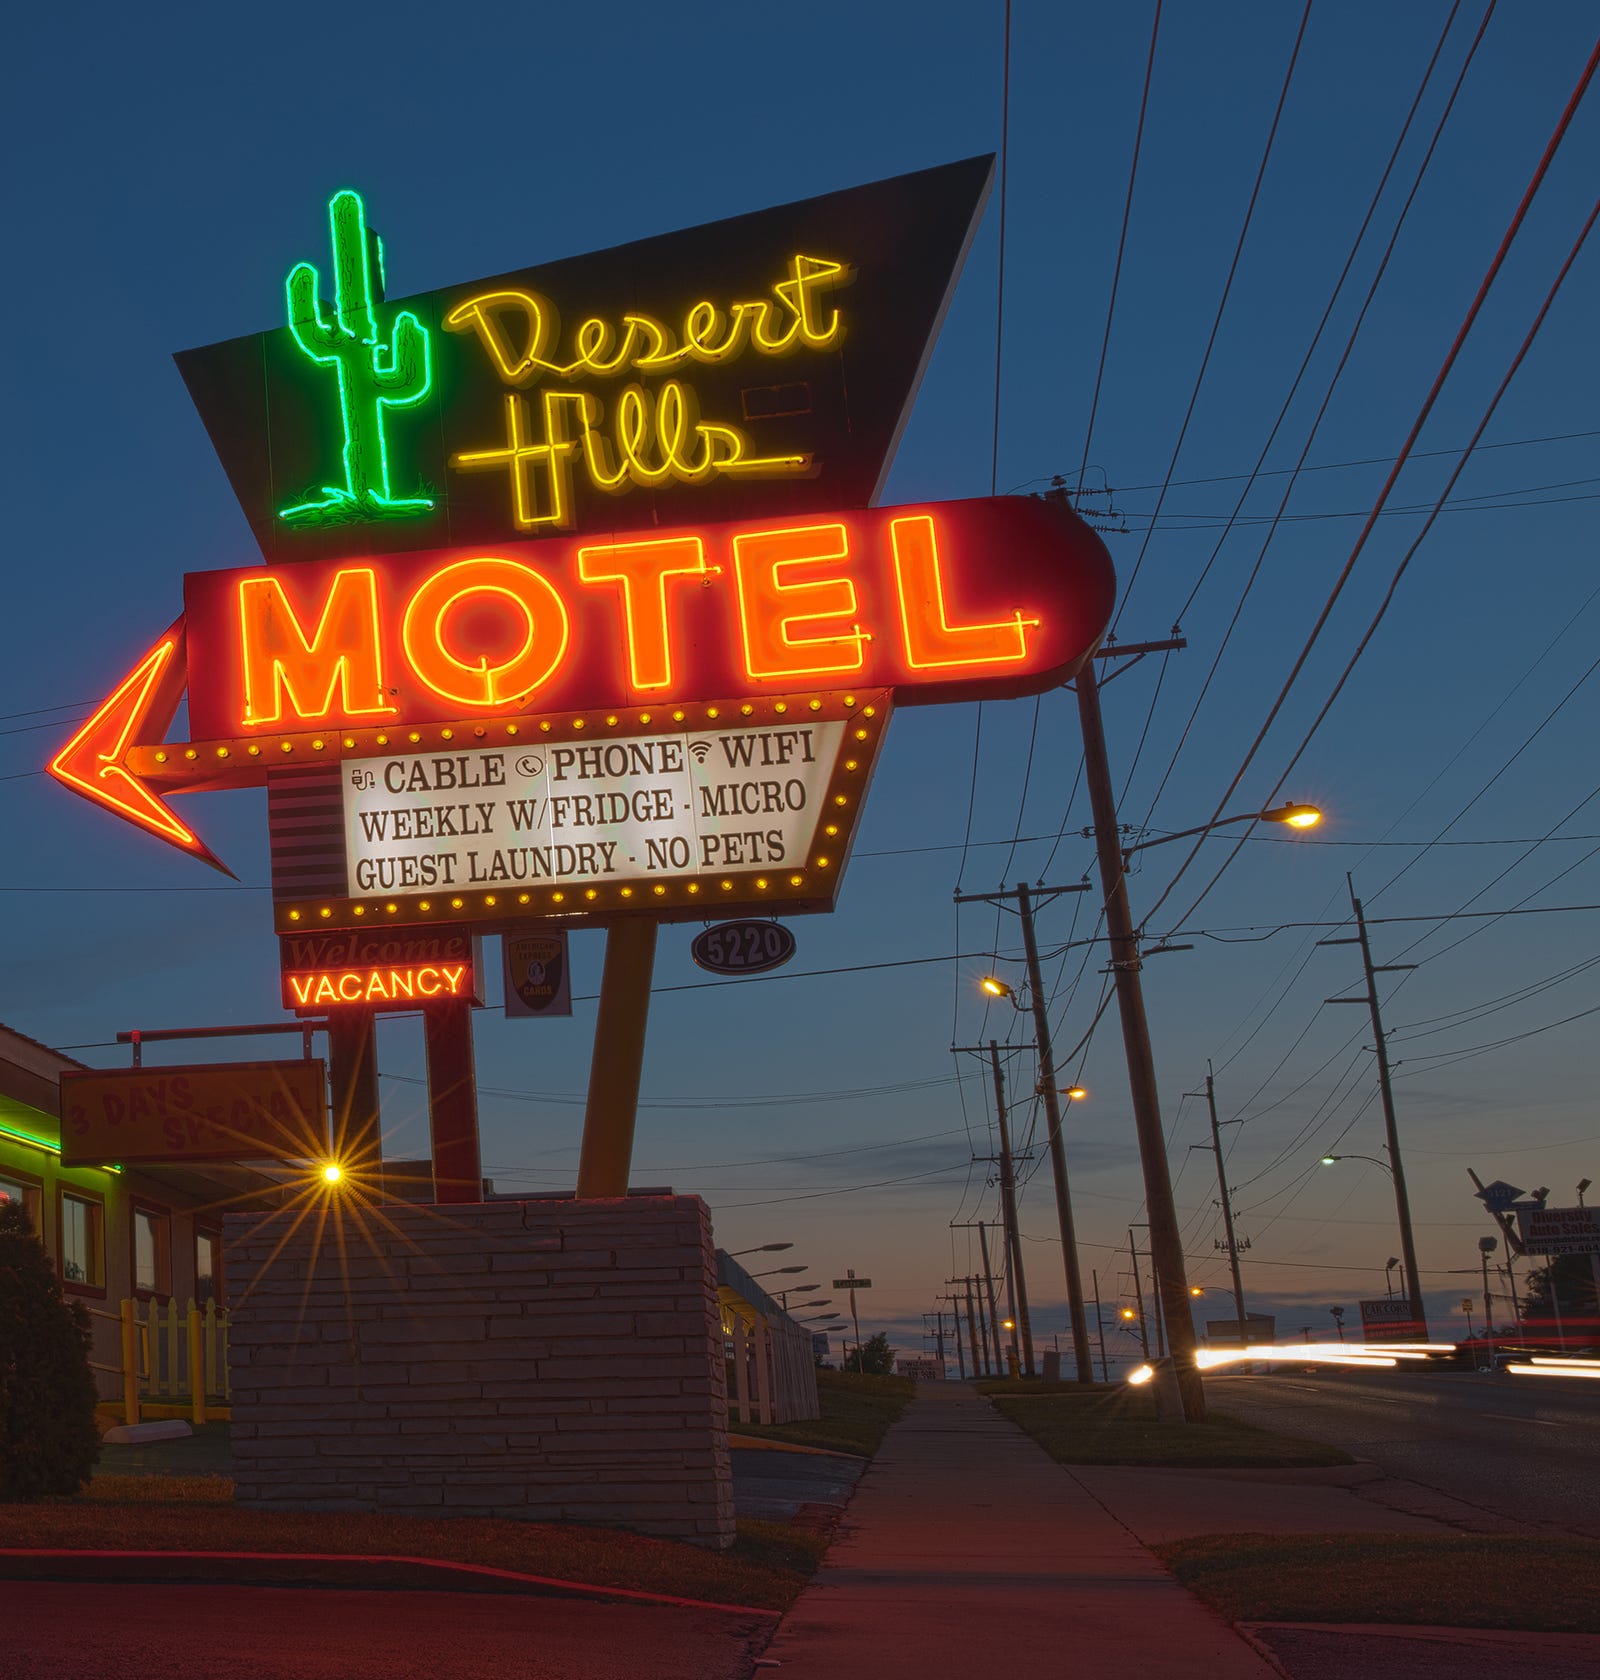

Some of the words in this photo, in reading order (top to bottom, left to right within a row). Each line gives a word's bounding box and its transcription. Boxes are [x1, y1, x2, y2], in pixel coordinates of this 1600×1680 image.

[446, 255, 844, 381] Desert
[453, 382, 814, 528] Hills
[238, 514, 1041, 729] MOTEL
[383, 753, 506, 794] CABLE
[551, 740, 684, 781] PHONE
[719, 729, 816, 768] WIFI
[358, 801, 496, 843] WEEKLY
[506, 788, 675, 832] W/FRIDGE
[699, 778, 807, 818] MICRO
[356, 852, 457, 891] GUEST
[467, 840, 617, 883] LAUNDRY
[645, 835, 690, 871] NO
[700, 829, 786, 867] PETS
[288, 933, 464, 970] Welcome
[515, 943, 556, 953] AMERICAN
[707, 927, 781, 965] 5220
[290, 966, 464, 1004] VACANCY
[523, 985, 553, 997] CARDS
[68, 1105, 91, 1136] 3
[102, 1077, 194, 1126] DAYS
[163, 1087, 314, 1150] SPECIAL
[1529, 1225, 1559, 1236] Auto
[1562, 1222, 1600, 1235] Sales
[1532, 1209, 1593, 1223] Diversity
